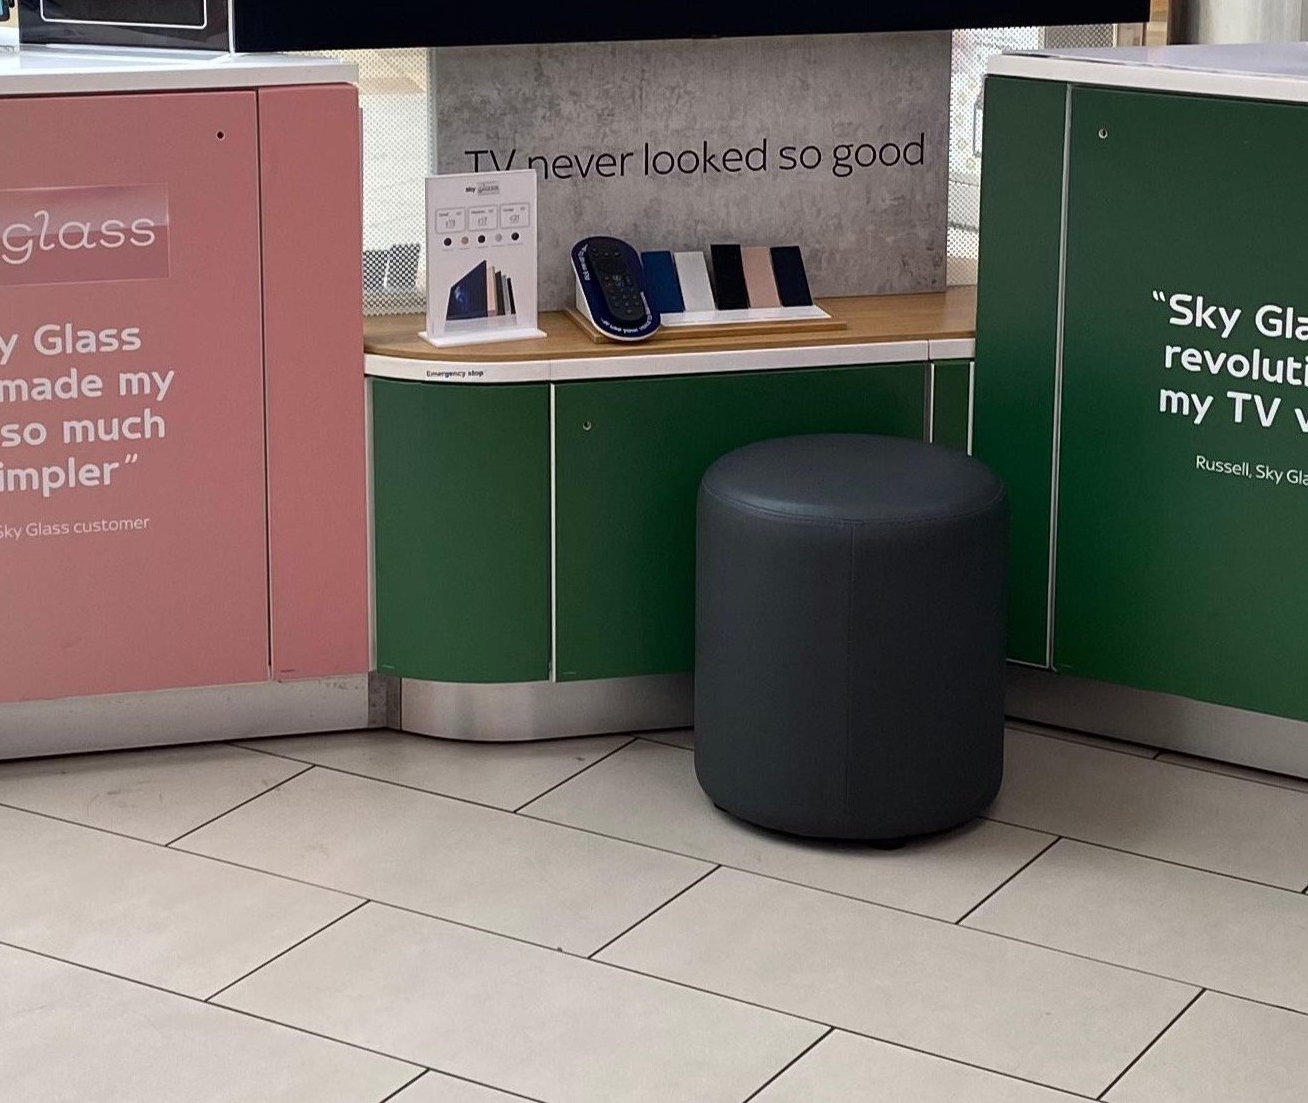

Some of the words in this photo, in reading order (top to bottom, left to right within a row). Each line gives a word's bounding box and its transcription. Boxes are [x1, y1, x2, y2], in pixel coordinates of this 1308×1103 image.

[465, 149, 516, 172] TV
[528, 151, 634, 179] never
[644, 140, 768, 177] looked
[778, 141, 822, 169] so
[832, 133, 926, 178] good
[1, 210, 156, 265] glass
[1152, 290, 1242, 339] “Sky
[33, 323, 142, 356] Glass
[119, 369, 176, 401] my
[426, 370, 465, 378] Emergency
[1159, 388, 1214, 425] my
[1226, 390, 1282, 428] TV
[0, 421, 47, 448] so
[62, 408, 166, 445] much
[1196, 455, 1253, 479] Russell,
[1255, 463, 1284, 485] Sky
[25, 520, 70, 537] Glass
[73, 516, 150, 534] customer
